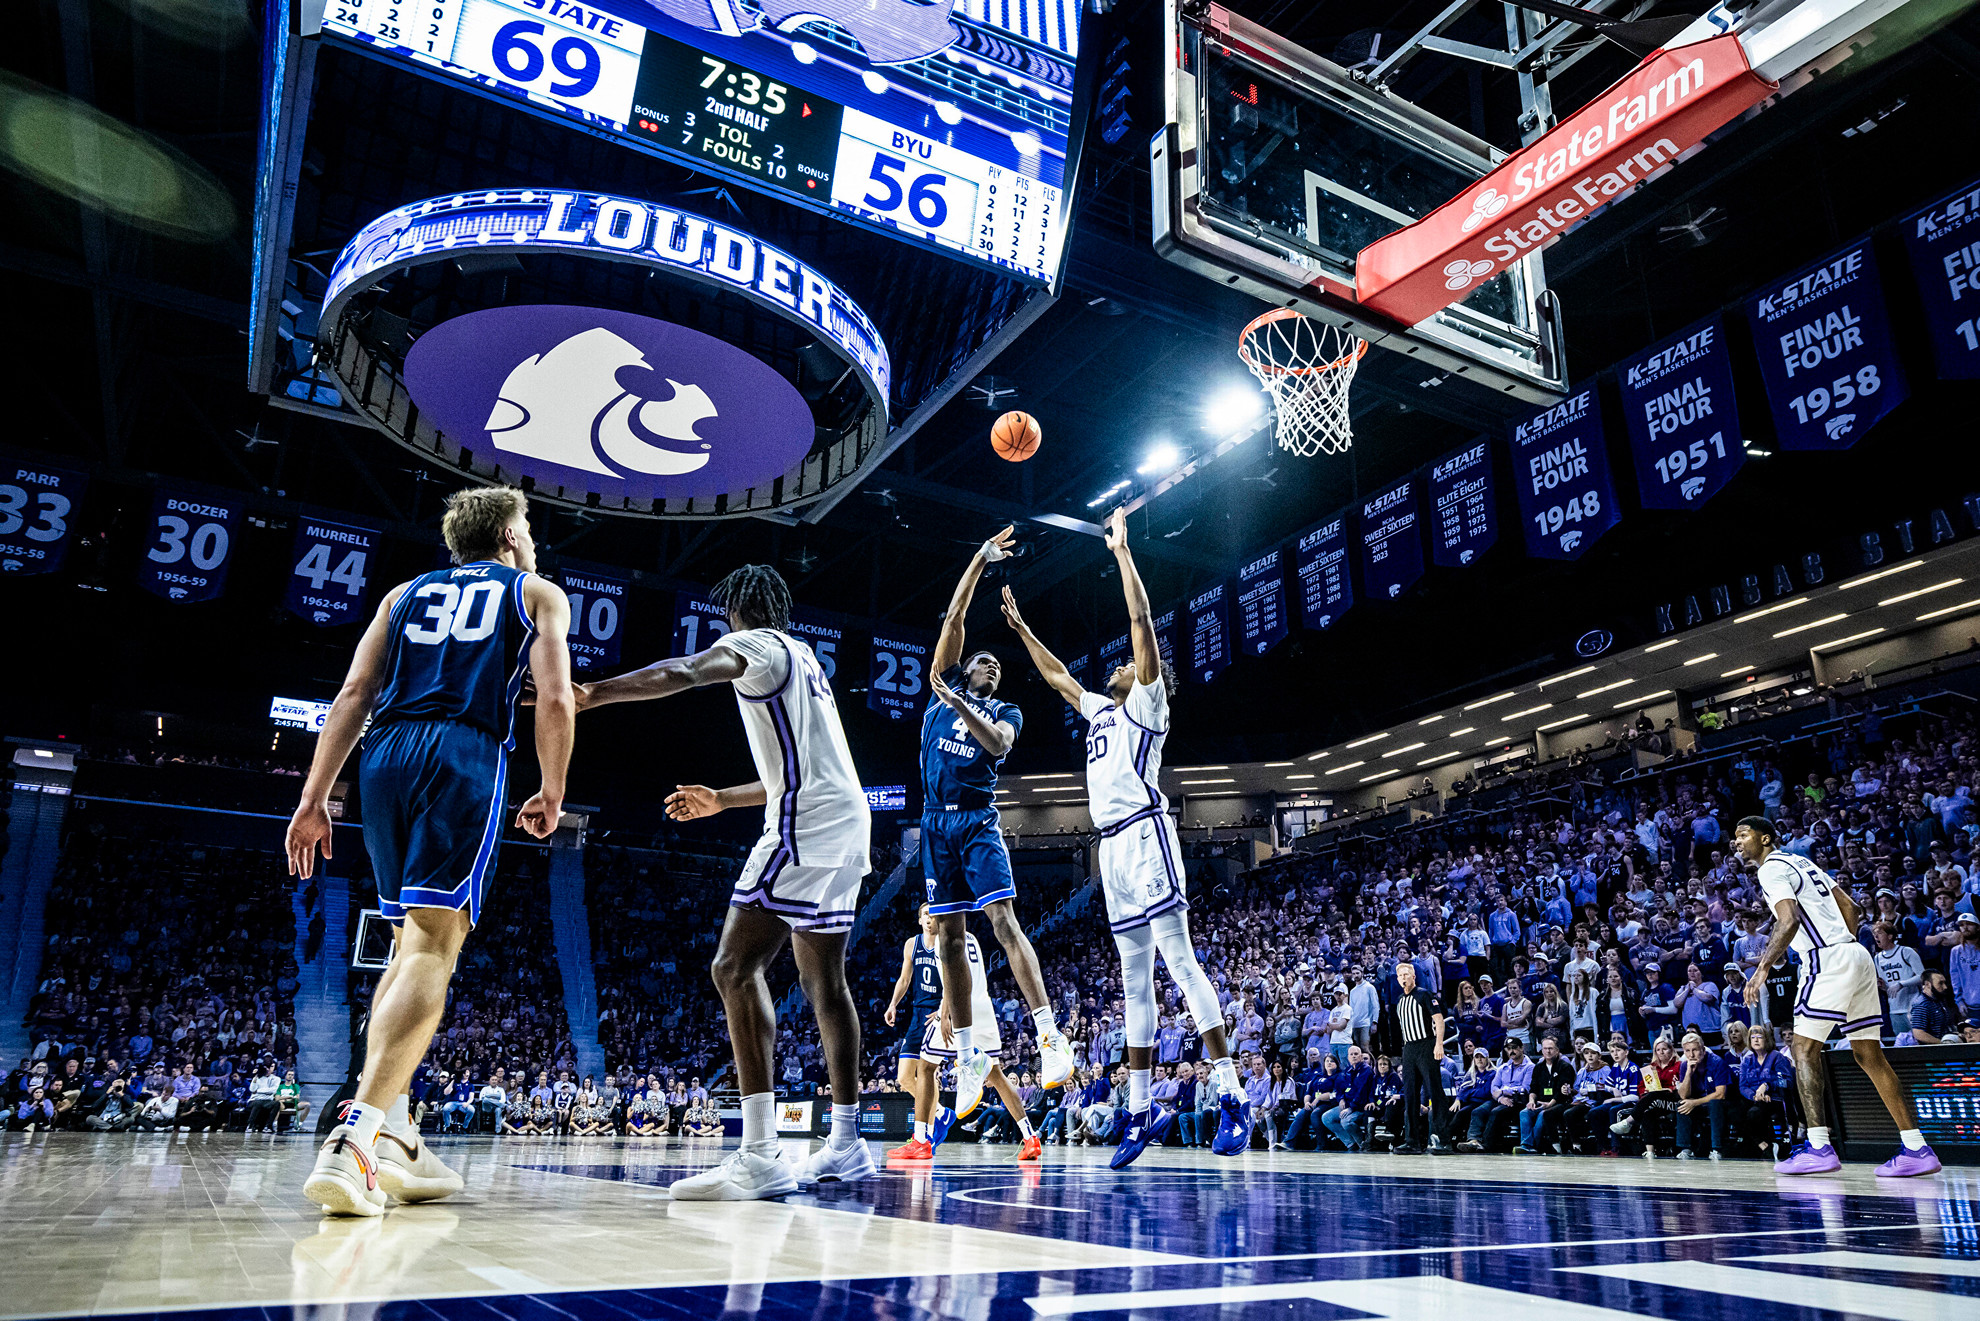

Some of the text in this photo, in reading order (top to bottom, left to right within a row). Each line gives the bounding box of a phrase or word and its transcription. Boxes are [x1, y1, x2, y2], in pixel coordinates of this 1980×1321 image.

[336, 8, 440, 40] 24 25 2
[387, 8, 444, 22] 2 0
[426, 40, 434, 52] 1
[492, 20, 601, 98] 69
[700, 56, 788, 114] 7:35
[634, 104, 670, 124] BONUS
[704, 97, 770, 132] 2nd HALF
[684, 112, 784, 160] 3 TOL 2
[892, 131, 932, 159] BYU
[682, 130, 787, 179] 7 FOULS 10
[798, 163, 830, 182] BONUS
[989, 166, 1056, 202] PLY PTS FLS
[863, 152, 948, 228] 56
[989, 184, 1050, 215] 0 12 2
[986, 212, 1046, 242] 4 2 1
[988, 198, 1048, 228] 2 11 3
[1917, 188, 1980, 238] K-ST
[980, 224, 1046, 256] 21 2 2
[1928, 220, 1962, 242] MEN'S
[536, 191, 834, 332] LOUDER
[978, 238, 1044, 270] 30 2 2
[1758, 249, 1862, 318] K-STATE
[1767, 273, 1858, 322] MEN'S BASKETBALL
[1780, 305, 1860, 356] FINAL
[1628, 326, 1714, 386] K-STATE
[1784, 326, 1864, 378] FOUR
[1635, 347, 1710, 390] MEN'S BASKETBALL
[1644, 376, 1711, 422] FINAL
[1790, 364, 1881, 424] 1958
[1516, 391, 1590, 442] K-STATE
[1521, 410, 1586, 446] MEN'S BASKETBALL
[1648, 397, 1713, 442] FOUR
[1433, 443, 1485, 480] K-STATE
[1530, 437, 1587, 477] FINAL
[1654, 431, 1726, 484] 1951
[16, 468, 60, 488] PARR
[1452, 480, 1468, 490] NCAA
[1532, 456, 1589, 496] FOUR
[1364, 483, 1410, 516] K-STATE
[1438, 477, 1486, 508] ELITE EIGHT
[1442, 493, 1484, 518] 1951 1964
[0, 484, 72, 542] 33
[166, 498, 229, 520] BOOZER
[1382, 516, 1396, 526] NCAA
[1442, 504, 1485, 528] 1958 1972
[1534, 490, 1600, 536] 1948
[306, 526, 370, 548] MURRELL
[1300, 519, 1340, 550] K-STATE
[1364, 512, 1414, 544] SWEET SIXTEEN
[1444, 514, 1486, 538] 1959 1973
[1444, 524, 1488, 548] 1961 1975
[0, 544, 46, 560] 955-58
[148, 515, 230, 571] 30
[1372, 541, 1388, 554] 2018
[1372, 550, 1388, 563] 2023
[294, 543, 367, 596] 44
[1240, 551, 1278, 578] K-STATE
[1298, 548, 1344, 576] SWEET SIXTEEN
[1306, 565, 1339, 586] 1972 1981
[156, 570, 208, 588] 1956-59
[566, 576, 622, 596] WILLIAMS
[1306, 574, 1340, 594] 1973 1982
[1656, 552, 1824, 634] KANSAS
[302, 595, 348, 612] 1962-64
[690, 600, 726, 616] EVANS
[1190, 584, 1223, 610] K-STATE
[1306, 592, 1320, 604] 1975
[1307, 601, 1321, 612] 1977
[404, 580, 506, 645] 30
[567, 593, 618, 640] 10
[1197, 610, 1216, 626] NCAA
[787, 621, 842, 638] BLACKMAN
[873, 637, 926, 654] RICHMOND
[874, 652, 922, 695] 23
[880, 696, 914, 709] 1986-88
[952, 717, 969, 742] 4
[938, 738, 976, 758] YOUNG
[1806, 870, 1830, 898] 5
[921, 983, 936, 993] YOUNG
[923, 966, 932, 984] 0
[1777, 984, 1784, 997] 0
[1916, 1098, 1980, 1118] OUT
